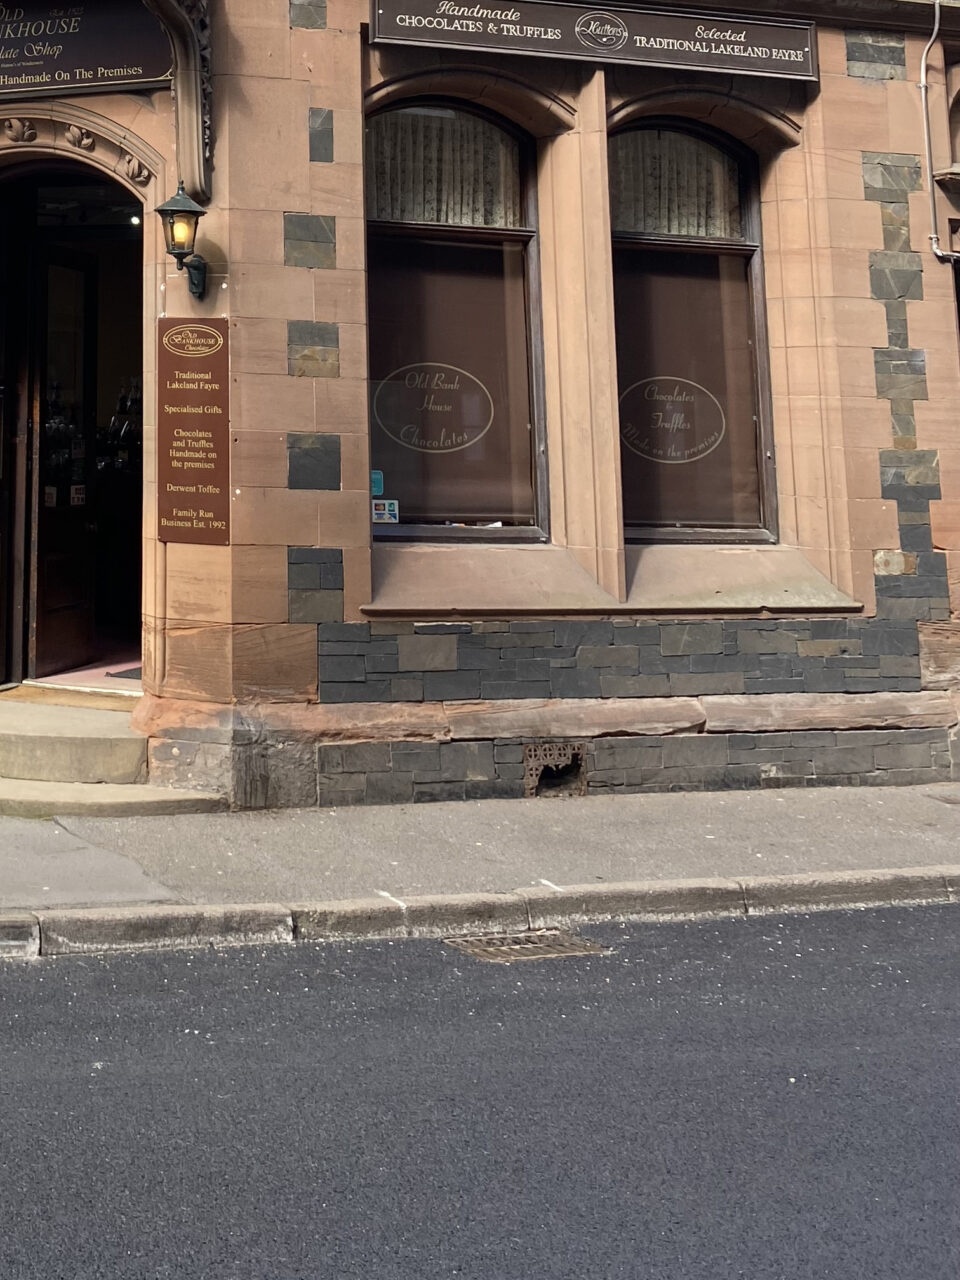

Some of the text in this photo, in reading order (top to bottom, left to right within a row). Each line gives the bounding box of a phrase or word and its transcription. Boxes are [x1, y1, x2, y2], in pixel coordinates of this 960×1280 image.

[436, 0, 521, 21] Handmade
[396, 15, 562, 40] CHOCOLATES & TRUFFLES
[695, 25, 747, 42] Selected
[24, 42, 63, 59] Shop
[634, 36, 804, 61] TRADITIONAL LAKELAND FAYRE
[0, 72, 51, 85] Handmade
[55, 70, 70, 81] On
[74, 68, 93, 79] The
[97, 65, 143, 78] Premises
[174, 371, 212, 379] Traditional
[405, 371, 460, 390] Old Bank
[167, 380, 220, 391] Lakeland Fayre
[644, 384, 695, 402] Chocolates
[164, 404, 222, 414] Specialised Gifts
[416, 394, 453, 412] House
[651, 412, 691, 433] Truffles
[174, 428, 213, 437] Chocolates
[400, 424, 468, 448] Chocolates
[172, 439, 214, 448] and Truffles
[653, 448, 663, 456] on
[667, 444, 681, 457] the
[685, 431, 719, 459] premises
[169, 449, 207, 458] Handmade
[171, 460, 215, 469] the premises
[167, 483, 221, 494] Derwent Toffee
[173, 508, 214, 519] Family Run
[161, 517, 192, 527] Business
[209, 521, 226, 529] 1992
